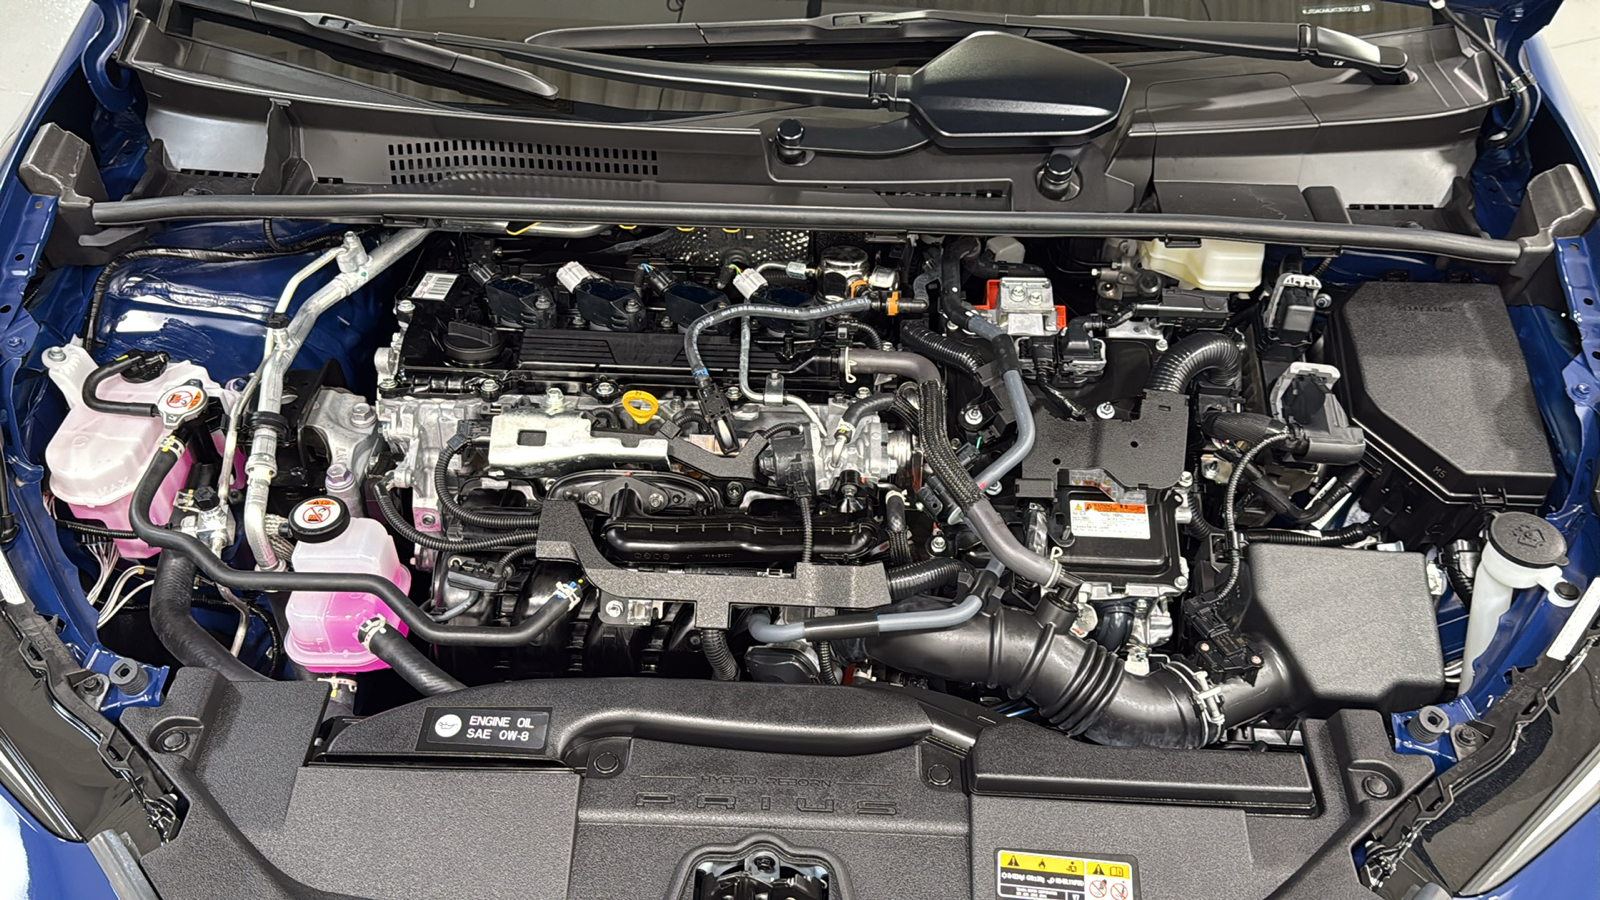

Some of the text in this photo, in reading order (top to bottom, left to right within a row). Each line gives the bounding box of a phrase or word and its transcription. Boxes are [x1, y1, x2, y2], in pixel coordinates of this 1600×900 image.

[469, 715, 535, 729] ENGINE OIL
[466, 728, 529, 742] SAE 0W-8
[700, 775, 832, 788] HYBRID REBORN
[635, 791, 897, 816] PRIUS
